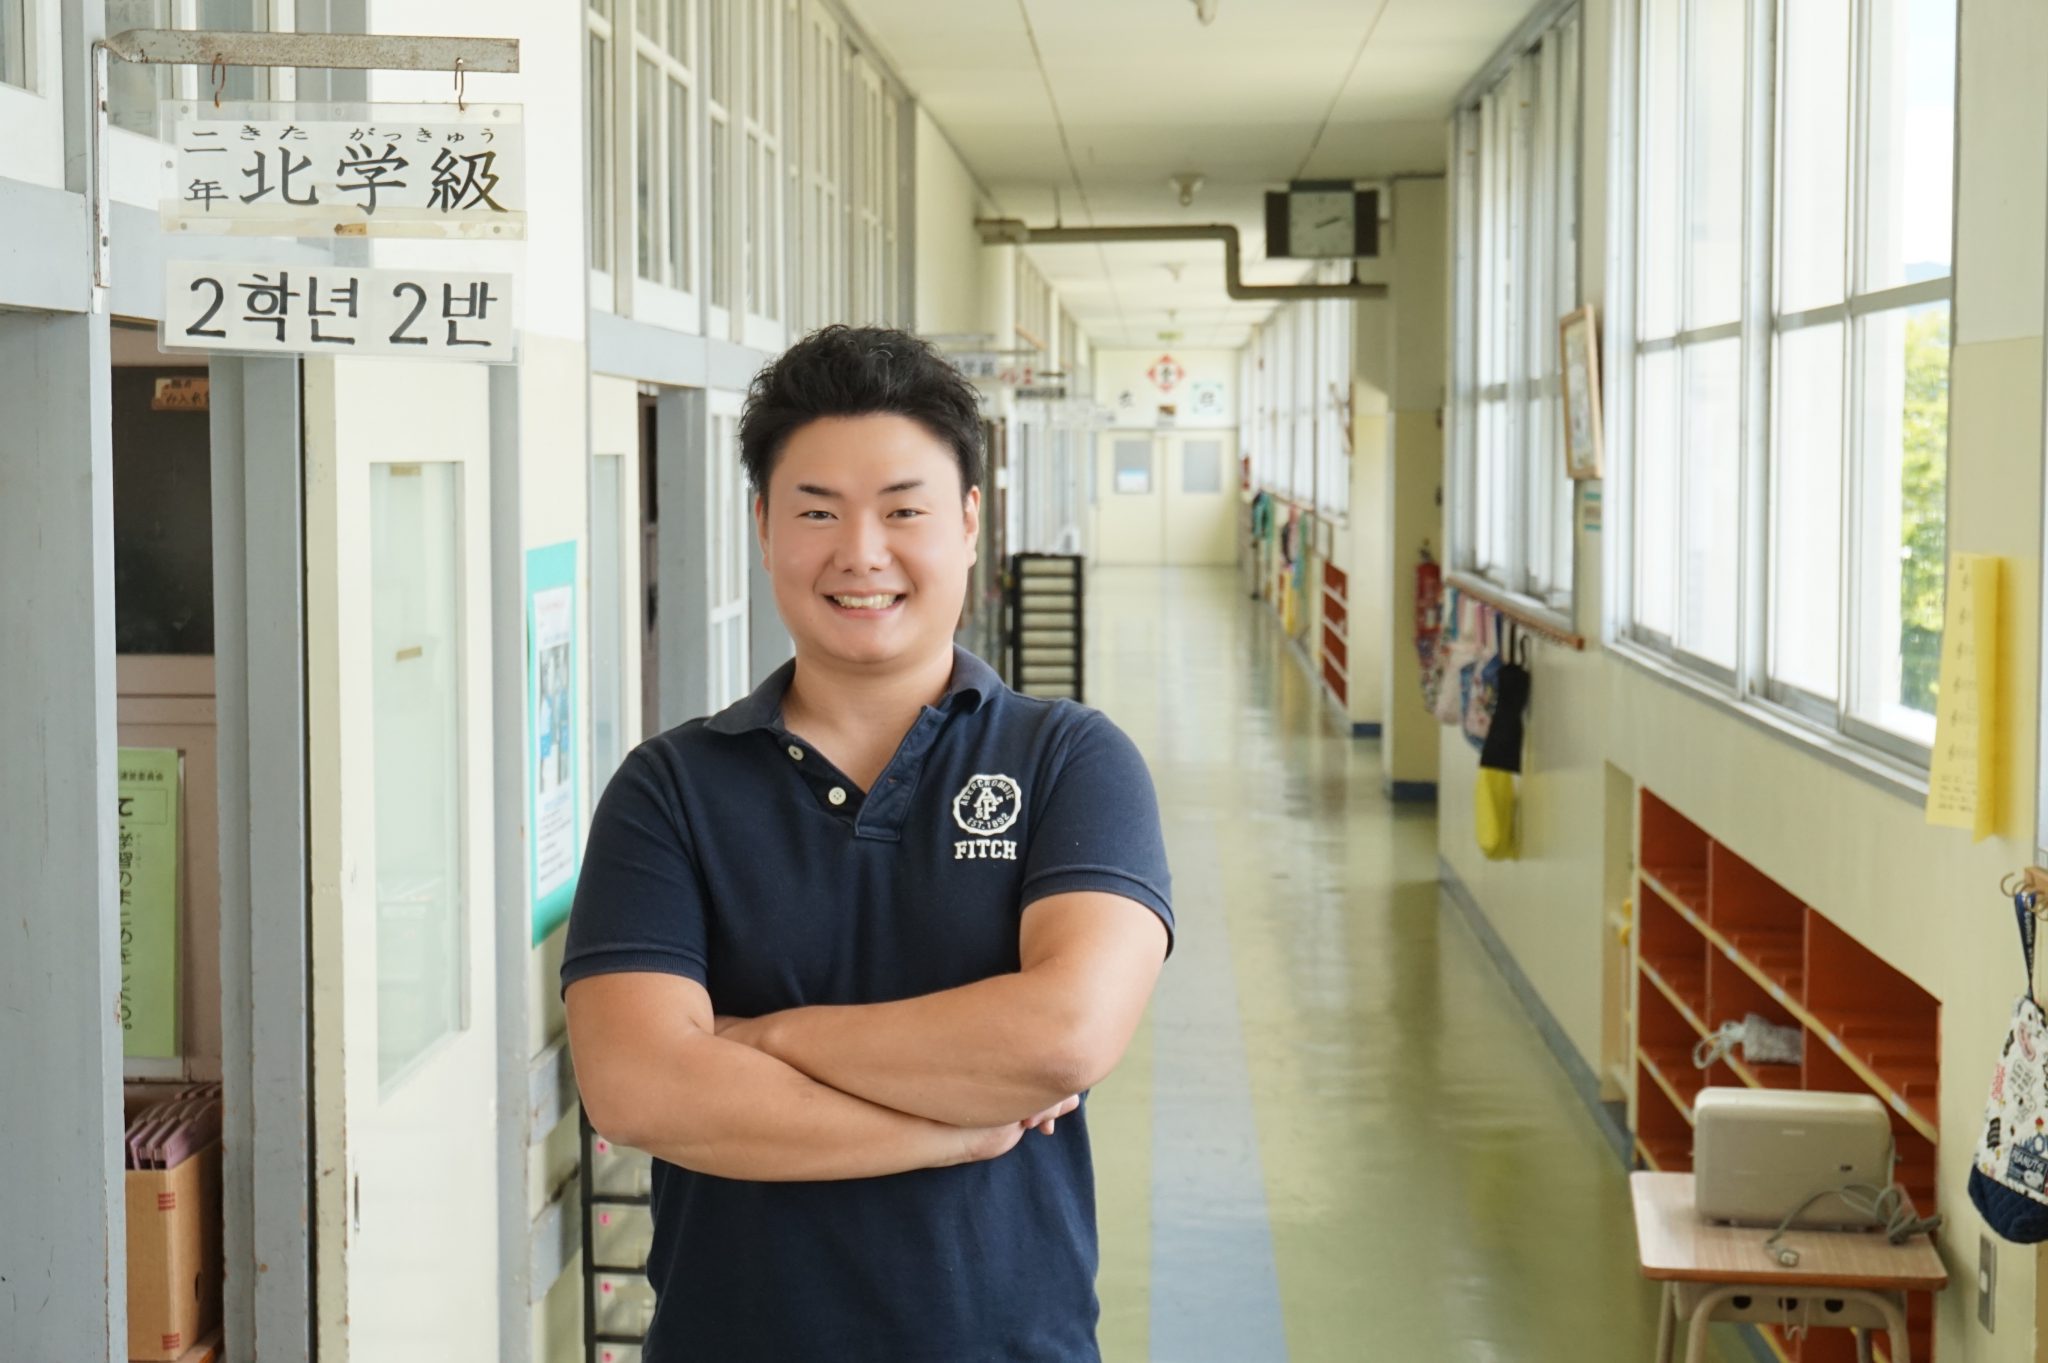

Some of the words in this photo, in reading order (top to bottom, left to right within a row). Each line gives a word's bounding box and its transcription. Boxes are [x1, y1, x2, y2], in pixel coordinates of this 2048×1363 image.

[240, 124, 308, 141] きた
[349, 127, 494, 143] がっきゅう
[184, 130, 229, 212] 二年
[239, 143, 509, 215] 北学級
[185, 271, 359, 345] 2학년
[388, 281, 498, 347] 2반
[954, 838, 1018, 860] FITCH
